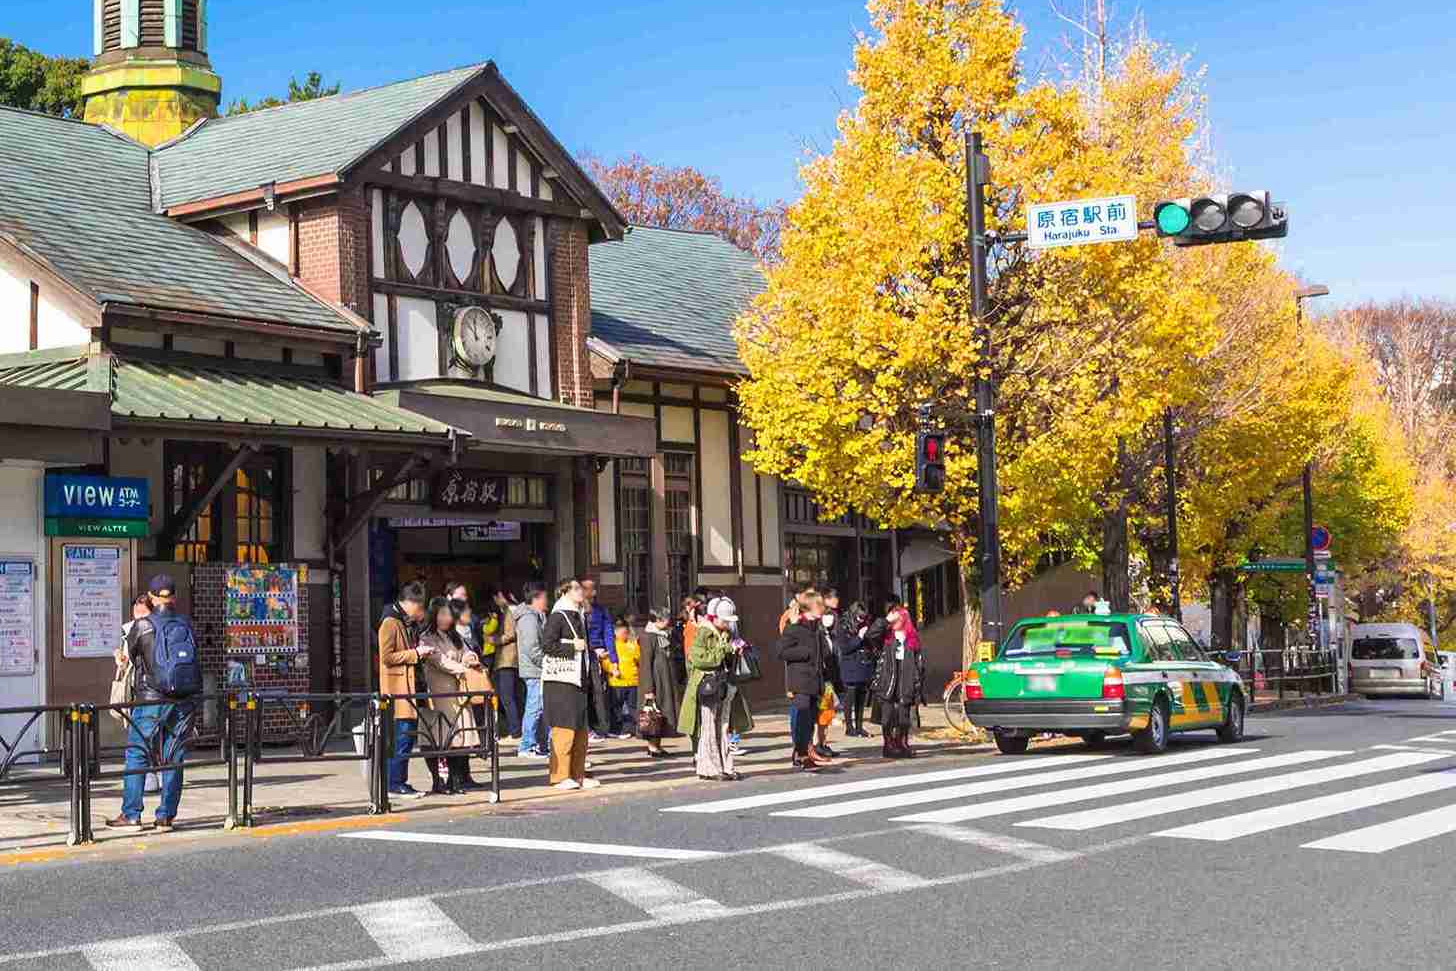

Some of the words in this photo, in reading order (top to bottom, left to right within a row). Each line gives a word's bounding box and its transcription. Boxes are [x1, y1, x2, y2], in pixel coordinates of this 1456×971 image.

[1037, 202, 1127, 229] 原宿駅前
[1044, 228, 1091, 242] Harajuku
[118, 487, 140, 499] ATM
